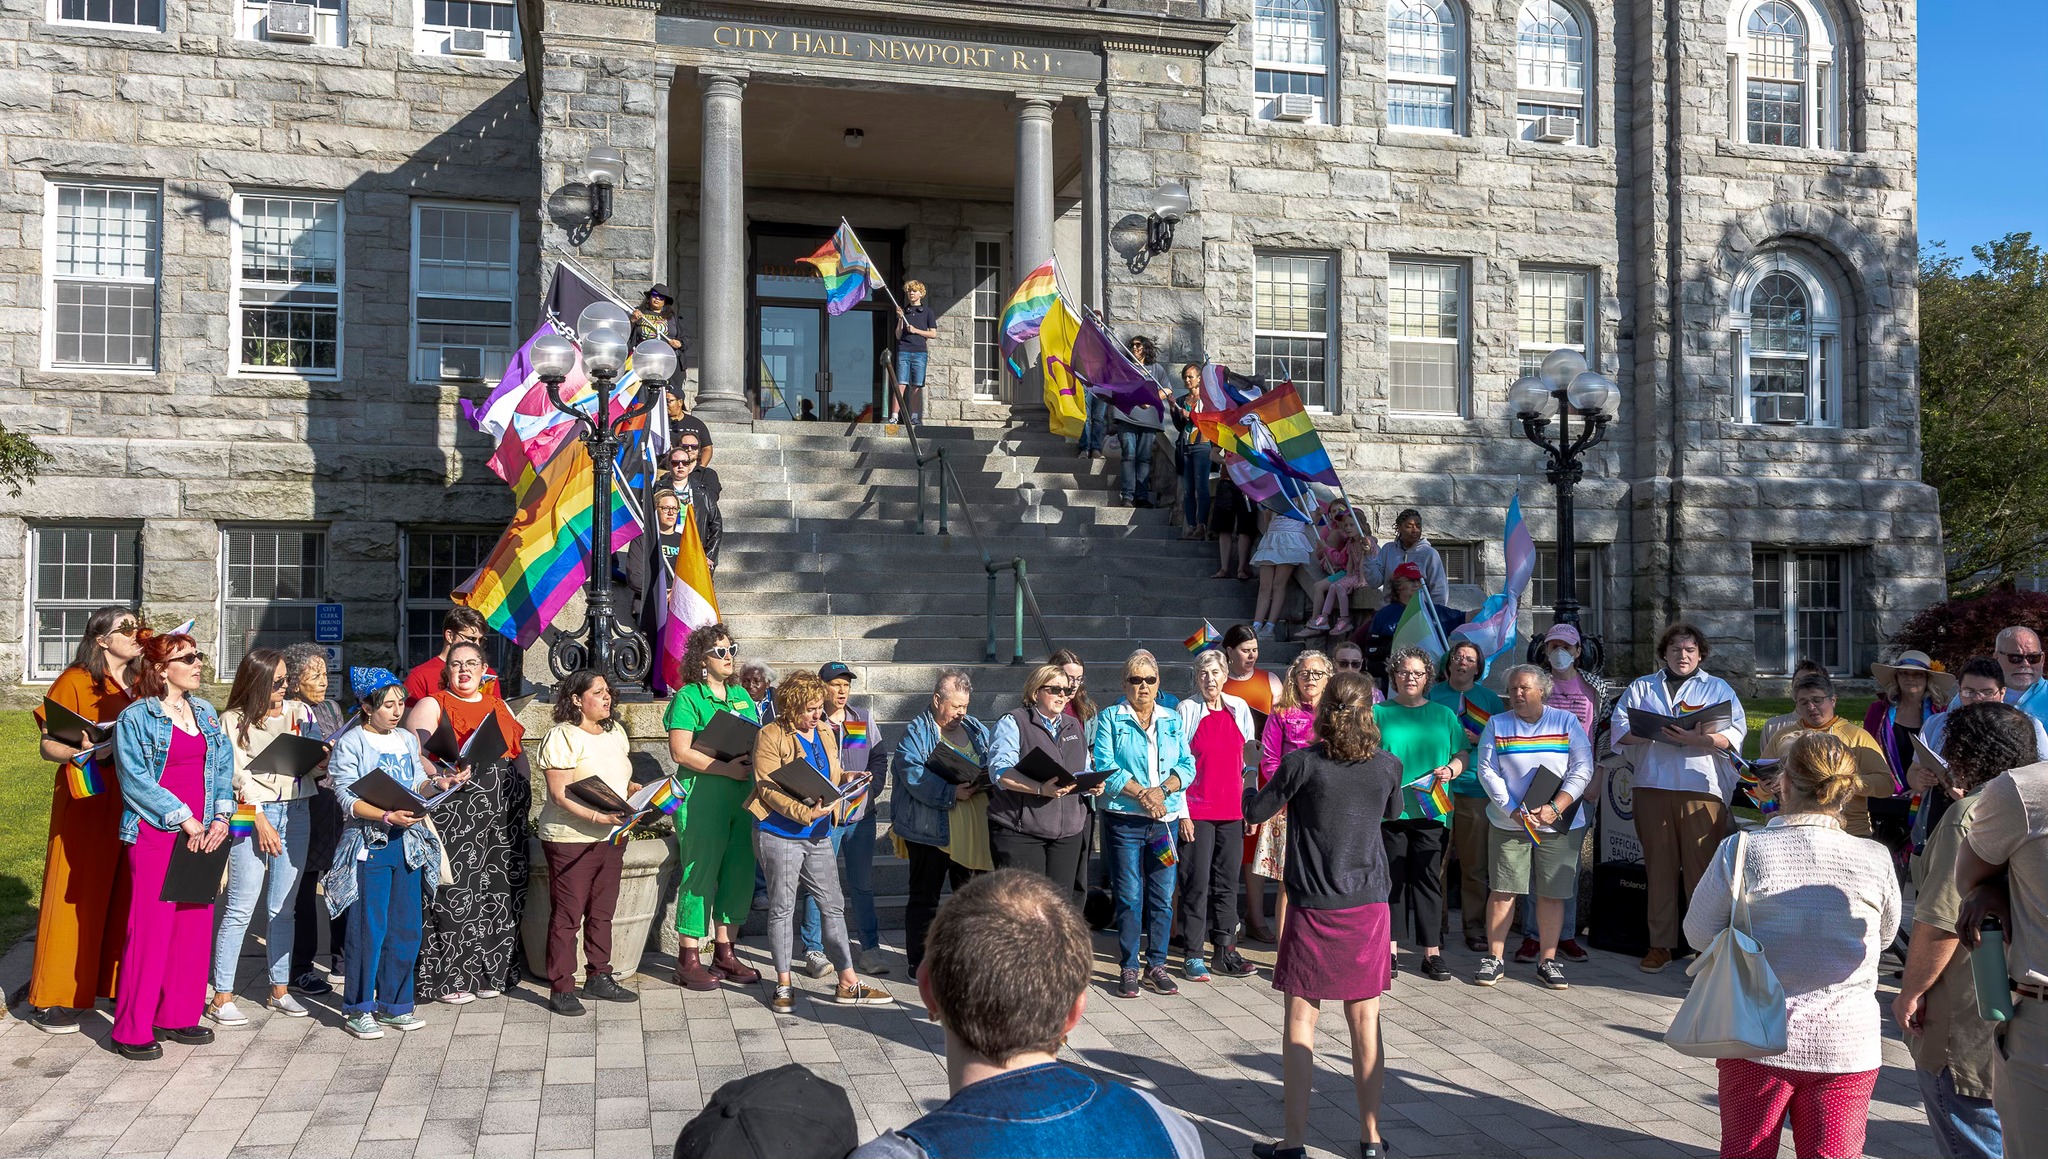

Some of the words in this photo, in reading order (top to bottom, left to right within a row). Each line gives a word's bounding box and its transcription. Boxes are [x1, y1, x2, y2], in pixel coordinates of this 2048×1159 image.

[713, 26, 780, 49] CITY
[792, 32, 854, 57] HALL
[867, 38, 997, 67] NEWPORT
[1610, 836, 1641, 853] OFFICIAL
[1612, 847, 1639, 862] BALLOT
[1619, 878, 1647, 891] Roland
